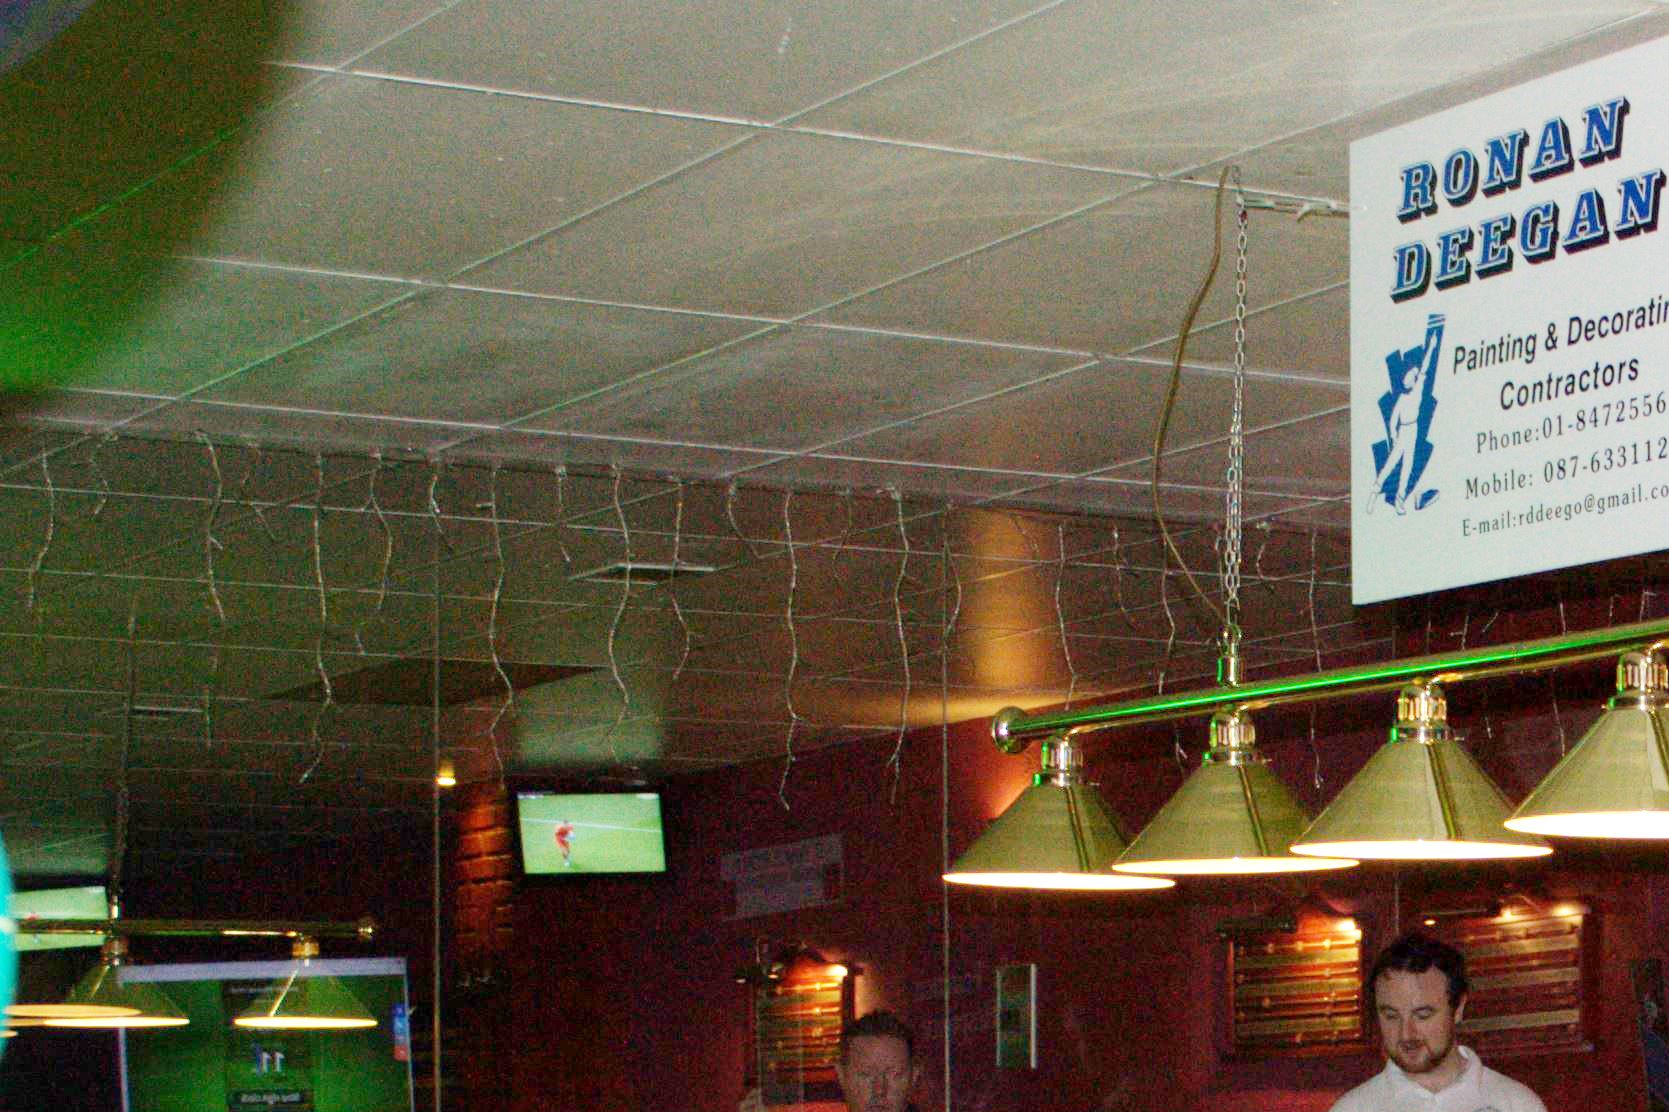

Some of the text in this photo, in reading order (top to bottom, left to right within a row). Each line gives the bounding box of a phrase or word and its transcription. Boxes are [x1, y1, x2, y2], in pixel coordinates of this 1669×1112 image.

[1396, 96, 1631, 224] RONAN
[1390, 167, 1667, 304] DEEGAN
[1453, 333, 1538, 375] Painting
[1545, 322, 1558, 352] &
[1500, 357, 1640, 411] Contractors
[1465, 468, 1534, 500] Mobile:
